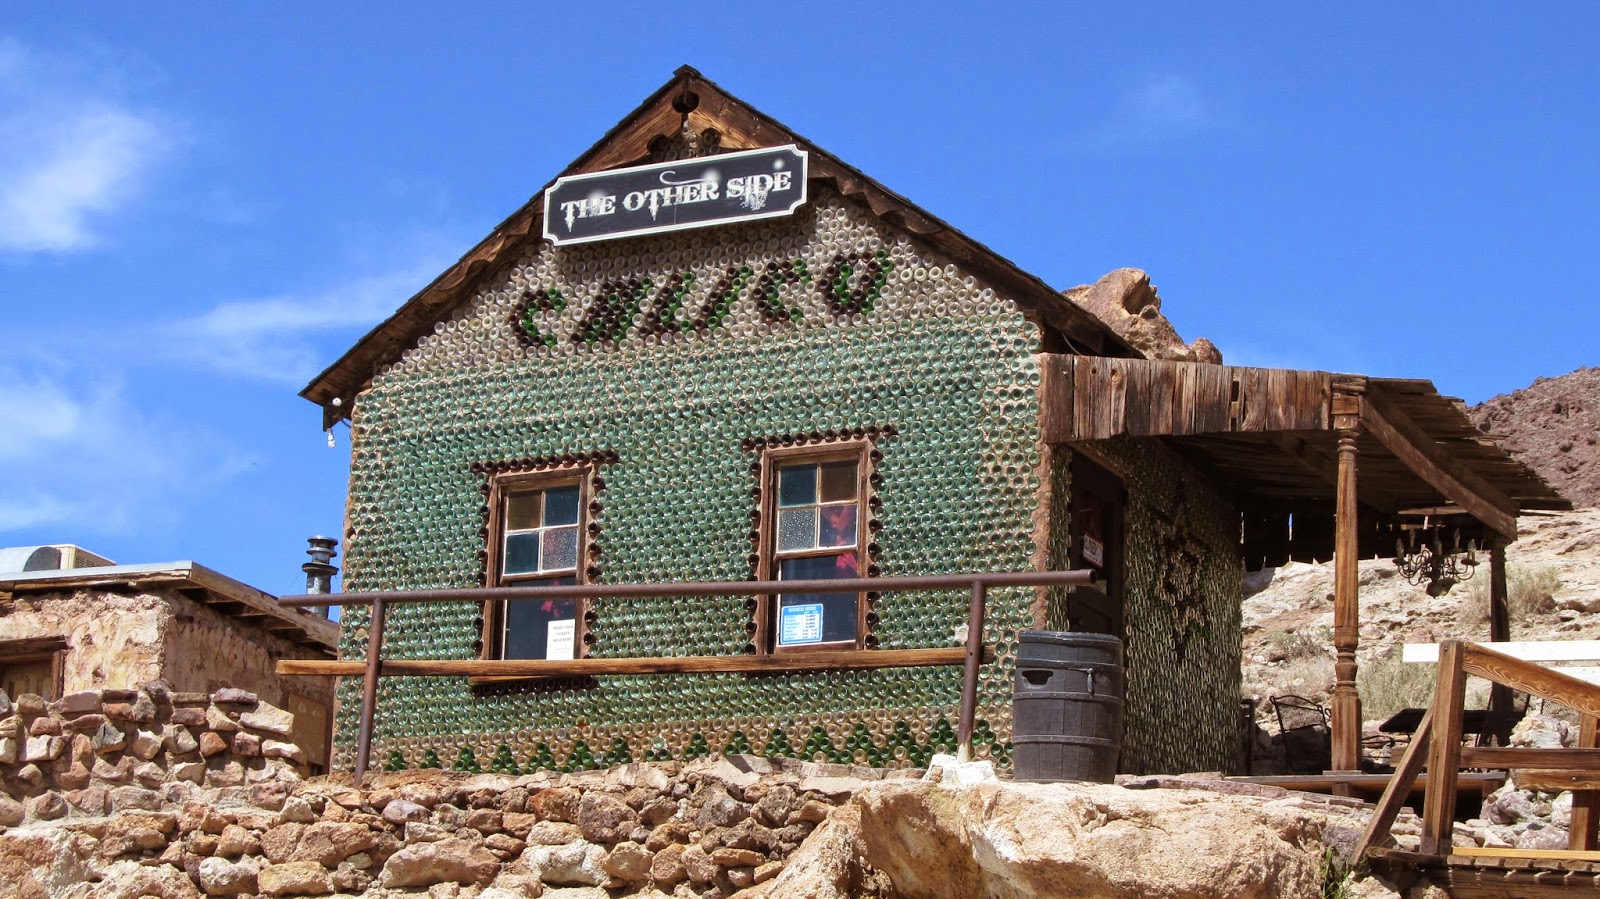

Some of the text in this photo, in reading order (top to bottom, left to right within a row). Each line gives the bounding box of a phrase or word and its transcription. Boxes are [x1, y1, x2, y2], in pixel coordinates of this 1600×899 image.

[560, 170, 793, 233] THE OTHER SIDE
